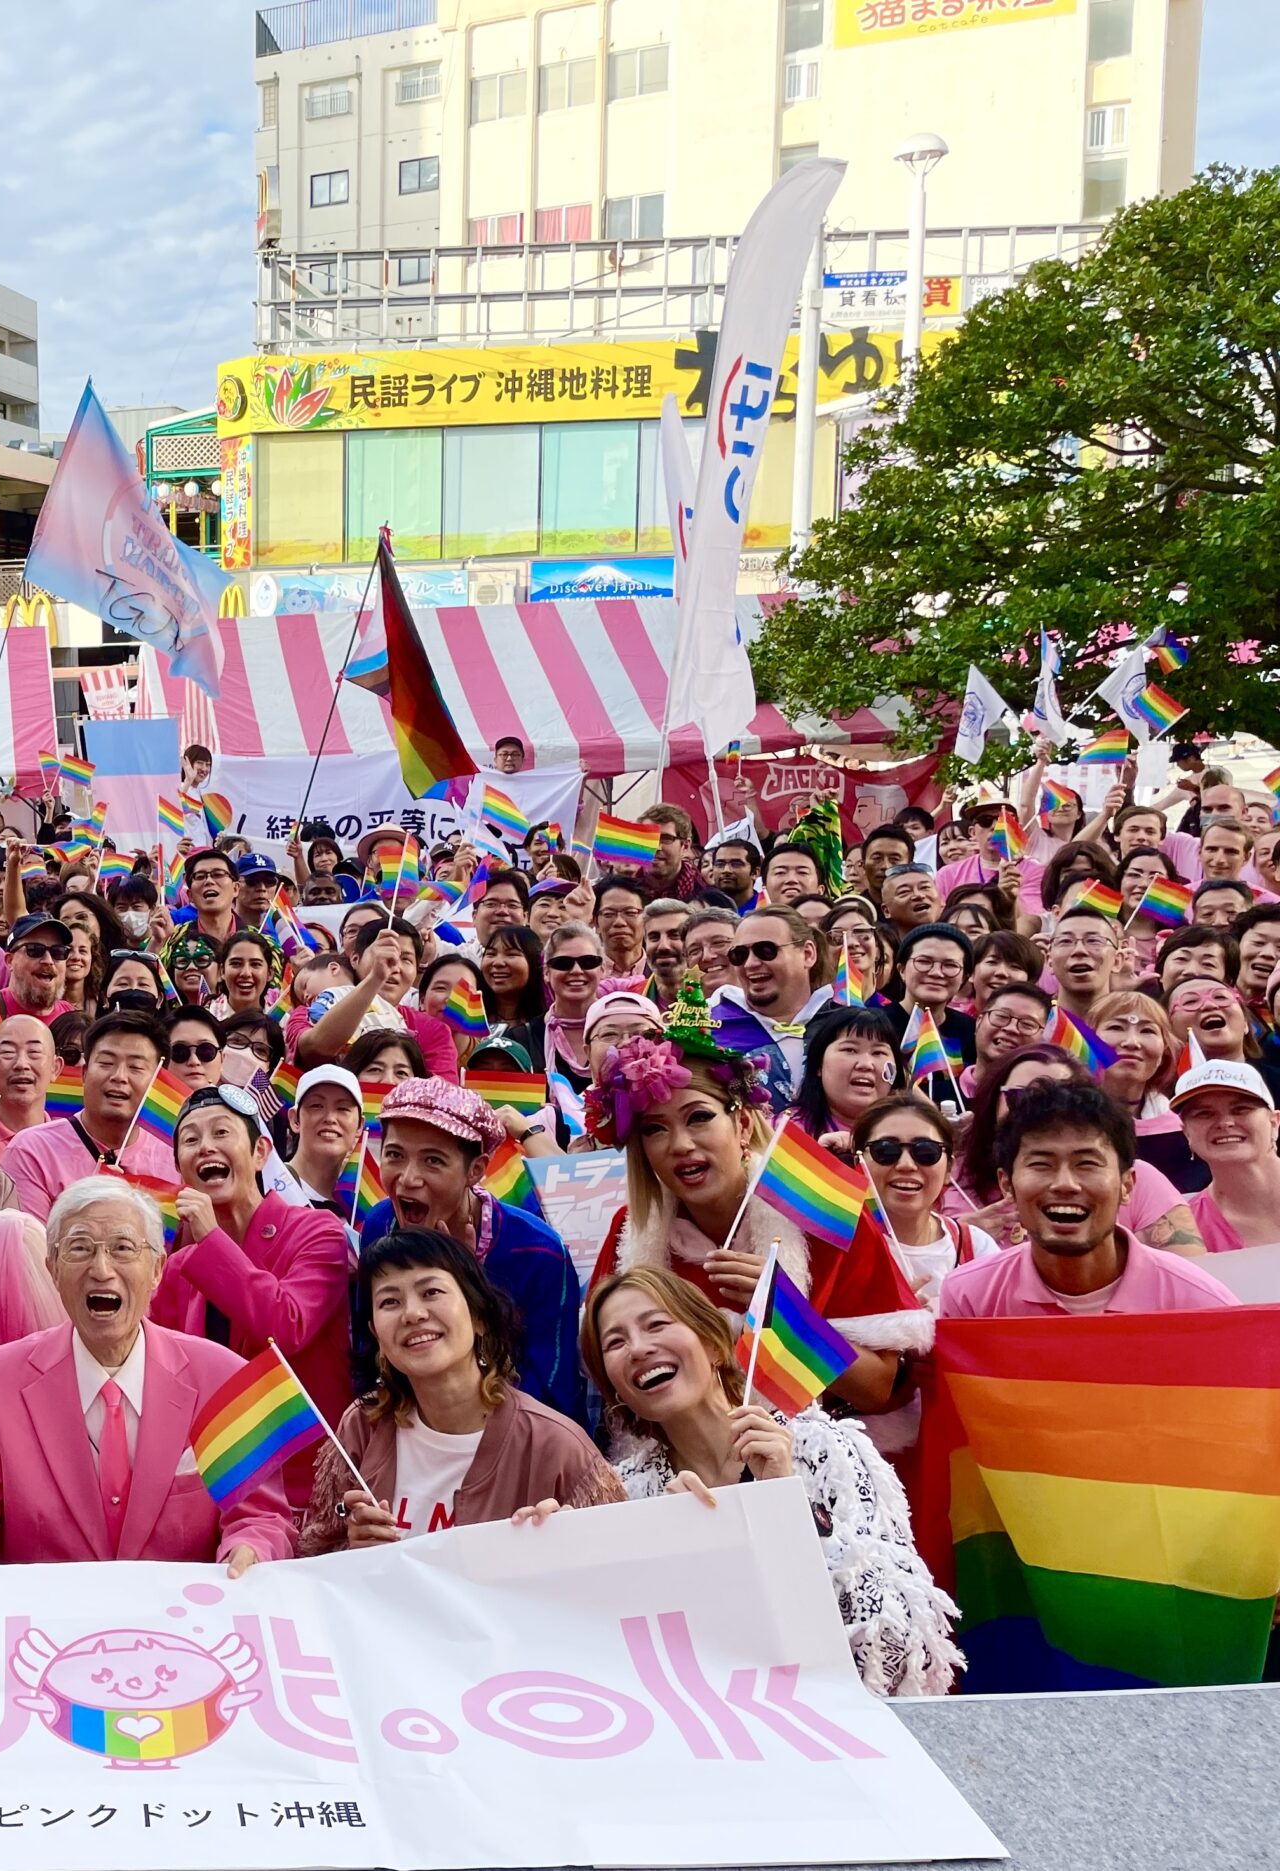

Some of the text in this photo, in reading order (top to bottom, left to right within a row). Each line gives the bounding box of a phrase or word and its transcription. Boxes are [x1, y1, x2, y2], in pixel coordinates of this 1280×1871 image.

[349, 365, 653, 410] 民謡ライブ 沖縄地料理
